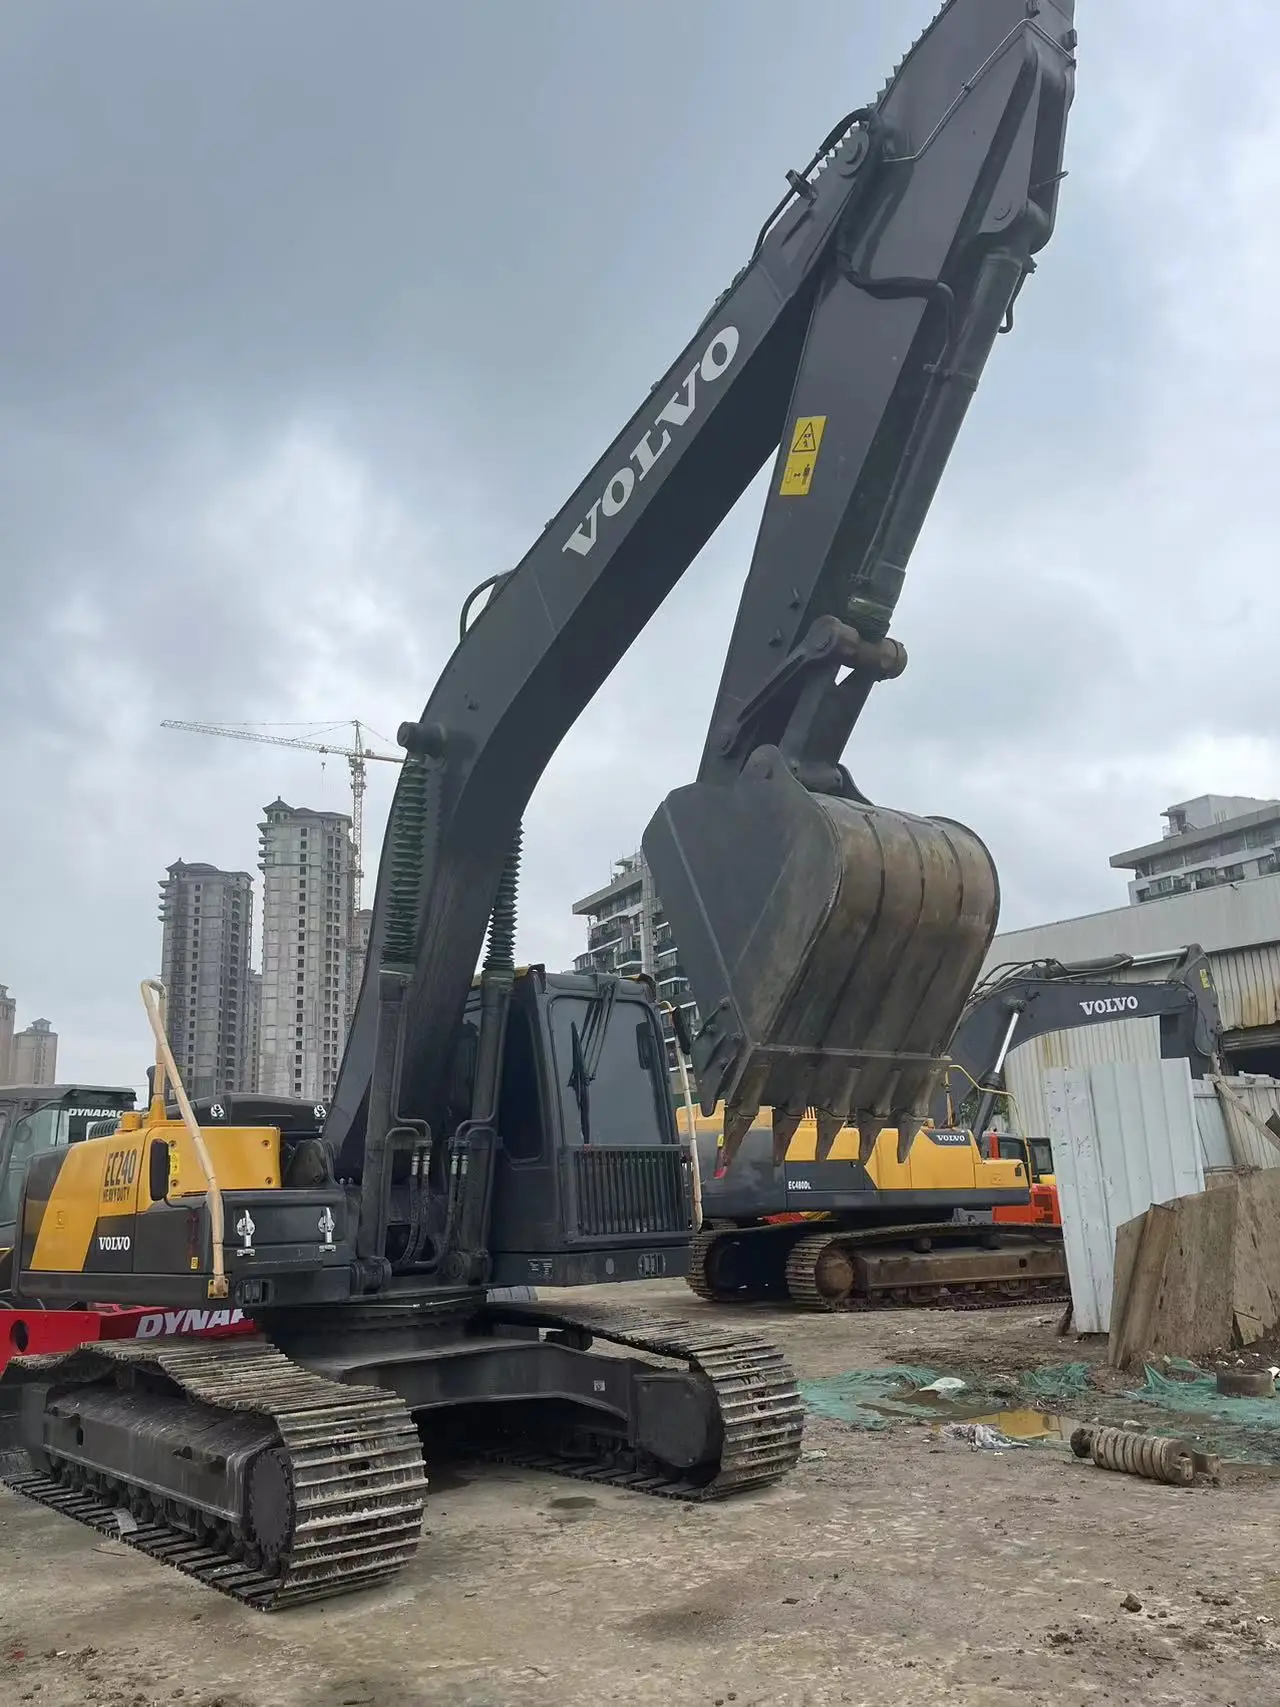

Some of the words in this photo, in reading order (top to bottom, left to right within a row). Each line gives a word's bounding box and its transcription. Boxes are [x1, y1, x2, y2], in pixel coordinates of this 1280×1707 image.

[561, 325, 740, 556] VOLVO
[1079, 996, 1138, 1015] VOLVO
[104, 1148, 137, 1187] EC240
[98, 1236, 131, 1250] VOLVO
